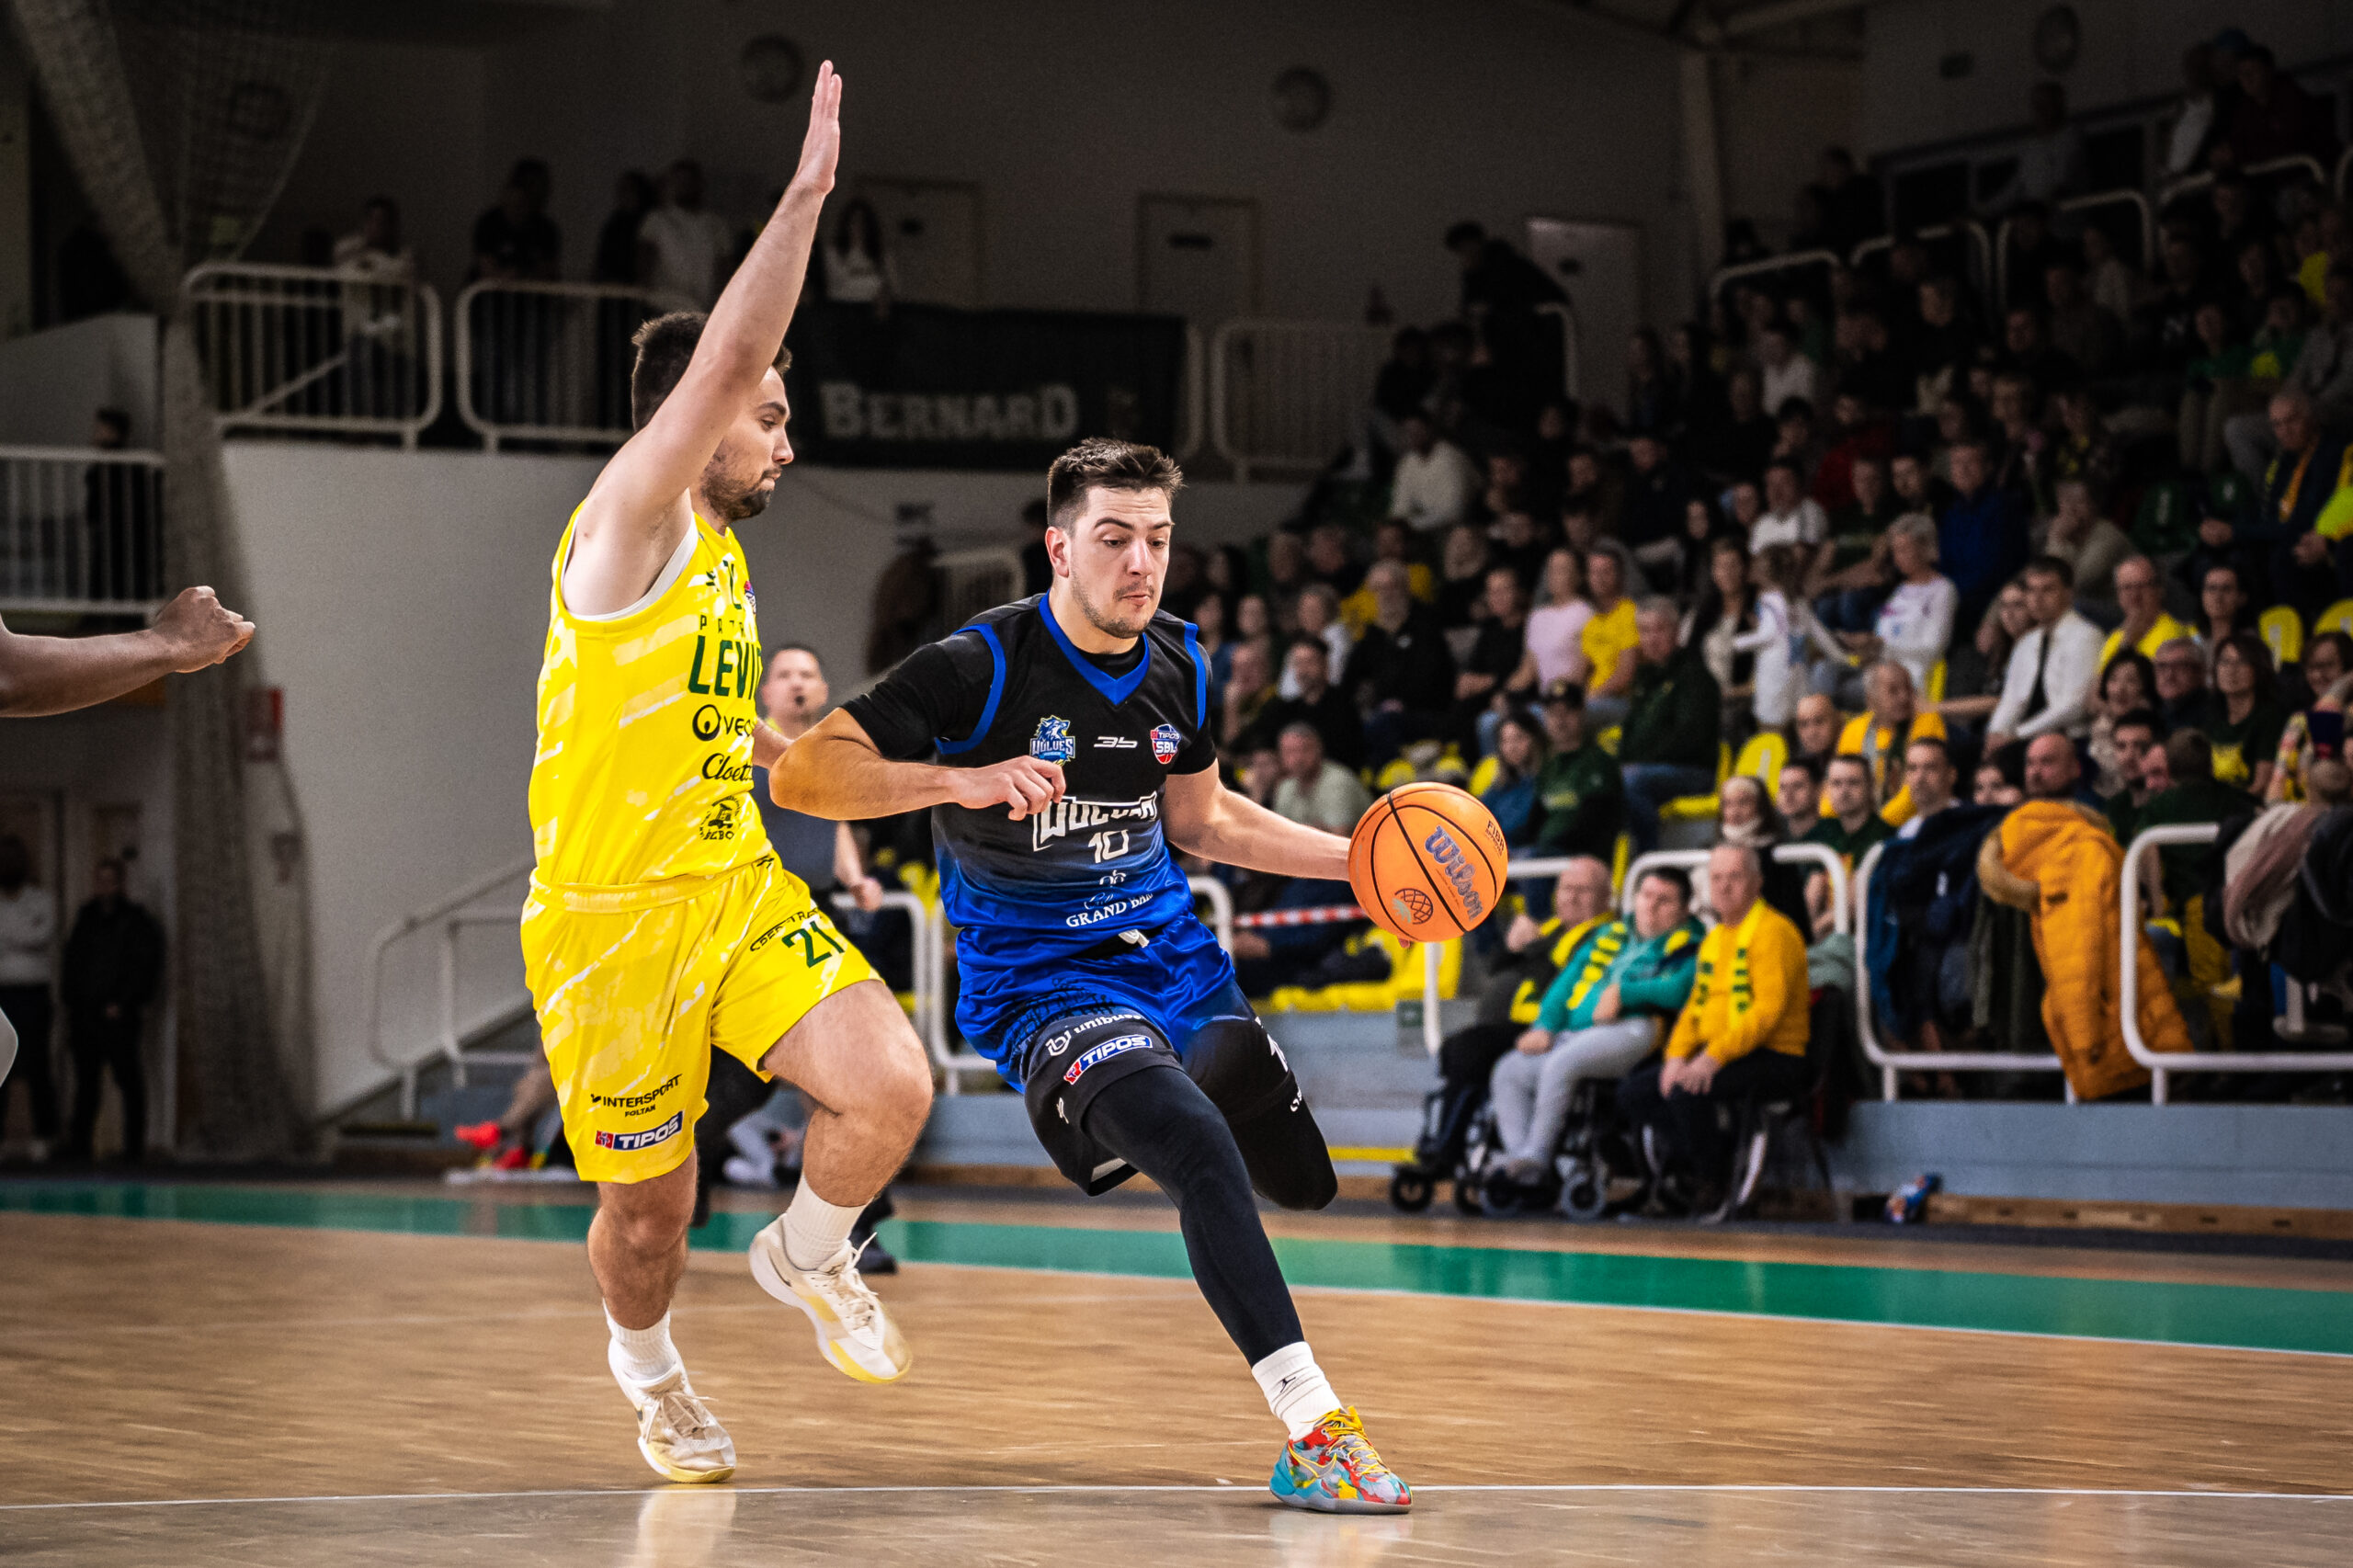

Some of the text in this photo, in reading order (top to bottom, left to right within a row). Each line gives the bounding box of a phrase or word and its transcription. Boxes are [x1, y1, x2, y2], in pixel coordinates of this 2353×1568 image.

[820, 381, 1077, 439] BERNARD
[723, 715, 755, 737] VEO
[1156, 742, 1176, 753] SBL
[1087, 828, 1129, 864] 10
[1487, 820, 1505, 851] FIBA
[1425, 825, 1483, 922] Wilson
[1066, 902, 1127, 927] GRAND
[781, 921, 845, 968] 21
[1083, 1036, 1146, 1064] TIPOS
[603, 1074, 682, 1108] INTERSPORT
[619, 1116, 679, 1148] TIPOS
